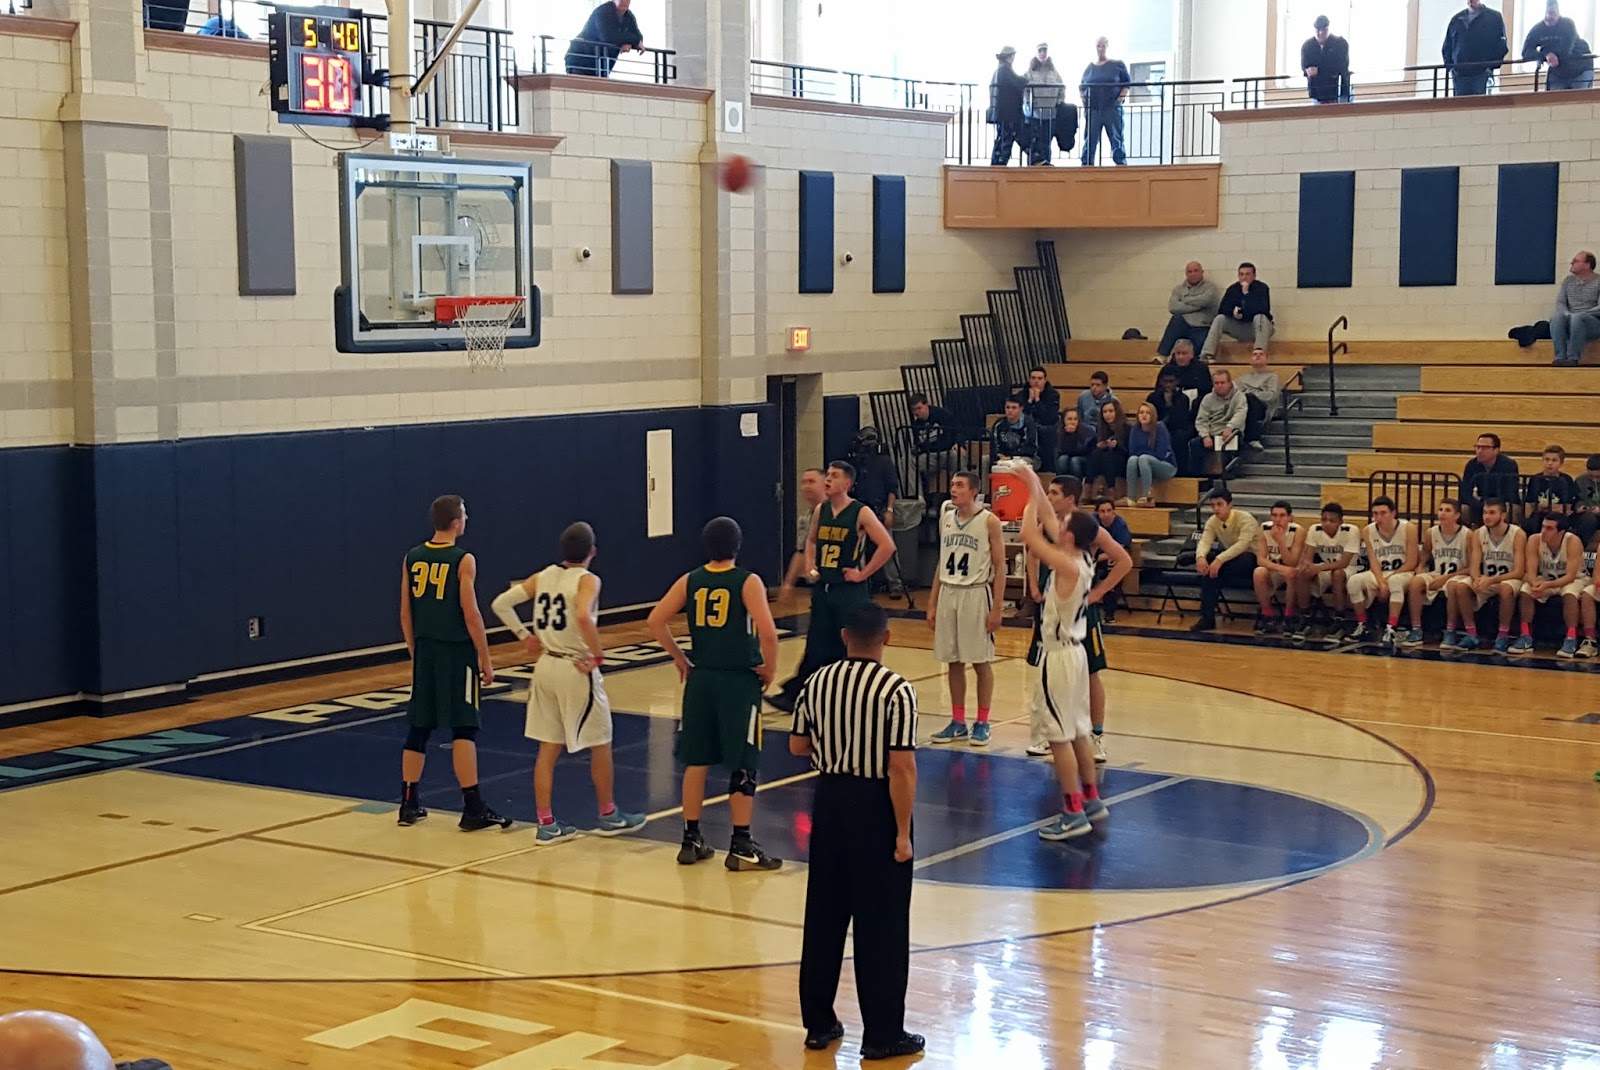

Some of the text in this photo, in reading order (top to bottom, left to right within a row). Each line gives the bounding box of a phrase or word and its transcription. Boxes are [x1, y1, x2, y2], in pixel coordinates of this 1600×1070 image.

[332, 23, 358, 51] 40
[303, 56, 350, 111] 30
[820, 543, 841, 568] 12
[943, 533, 979, 551] PANTHERS
[411, 560, 450, 600] 34
[945, 551, 969, 576] 44
[537, 592, 568, 631] 33
[693, 587, 730, 627] 13
